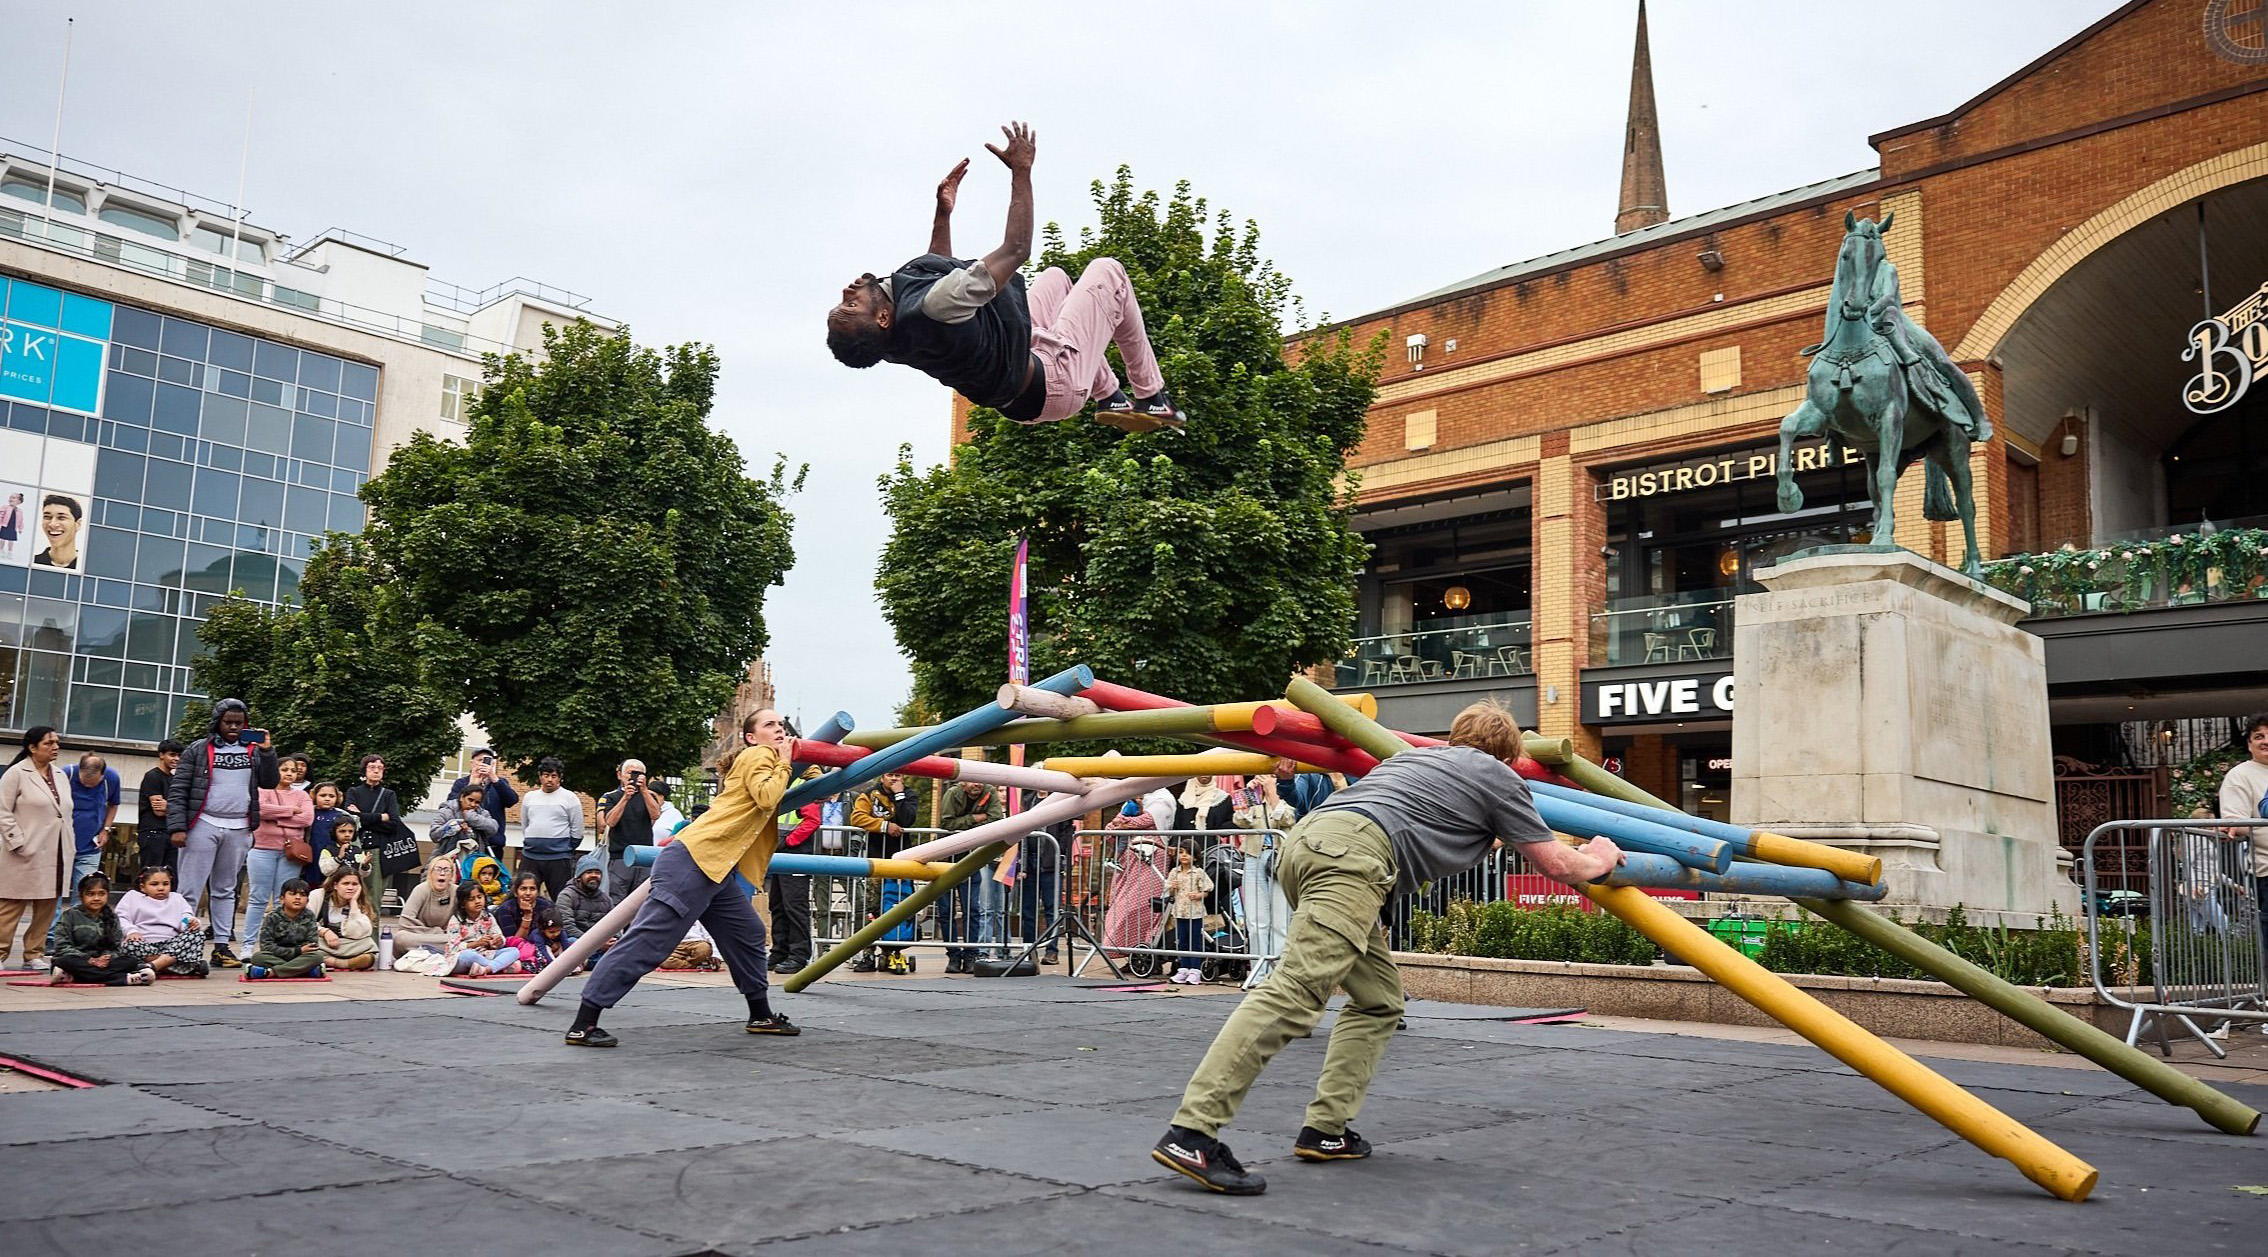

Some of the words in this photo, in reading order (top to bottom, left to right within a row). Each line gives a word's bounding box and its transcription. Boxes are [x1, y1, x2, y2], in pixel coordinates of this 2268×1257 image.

[3, 370, 42, 384] PRICES
[1612, 459, 1735, 500] BISTROT
[1749, 444, 1859, 479] PIRRE
[1598, 679, 1700, 717] FIVE
[214, 754, 250, 764] BOSS
[1709, 758, 1732, 769] OPE
[1519, 894, 1546, 904] FIVE
